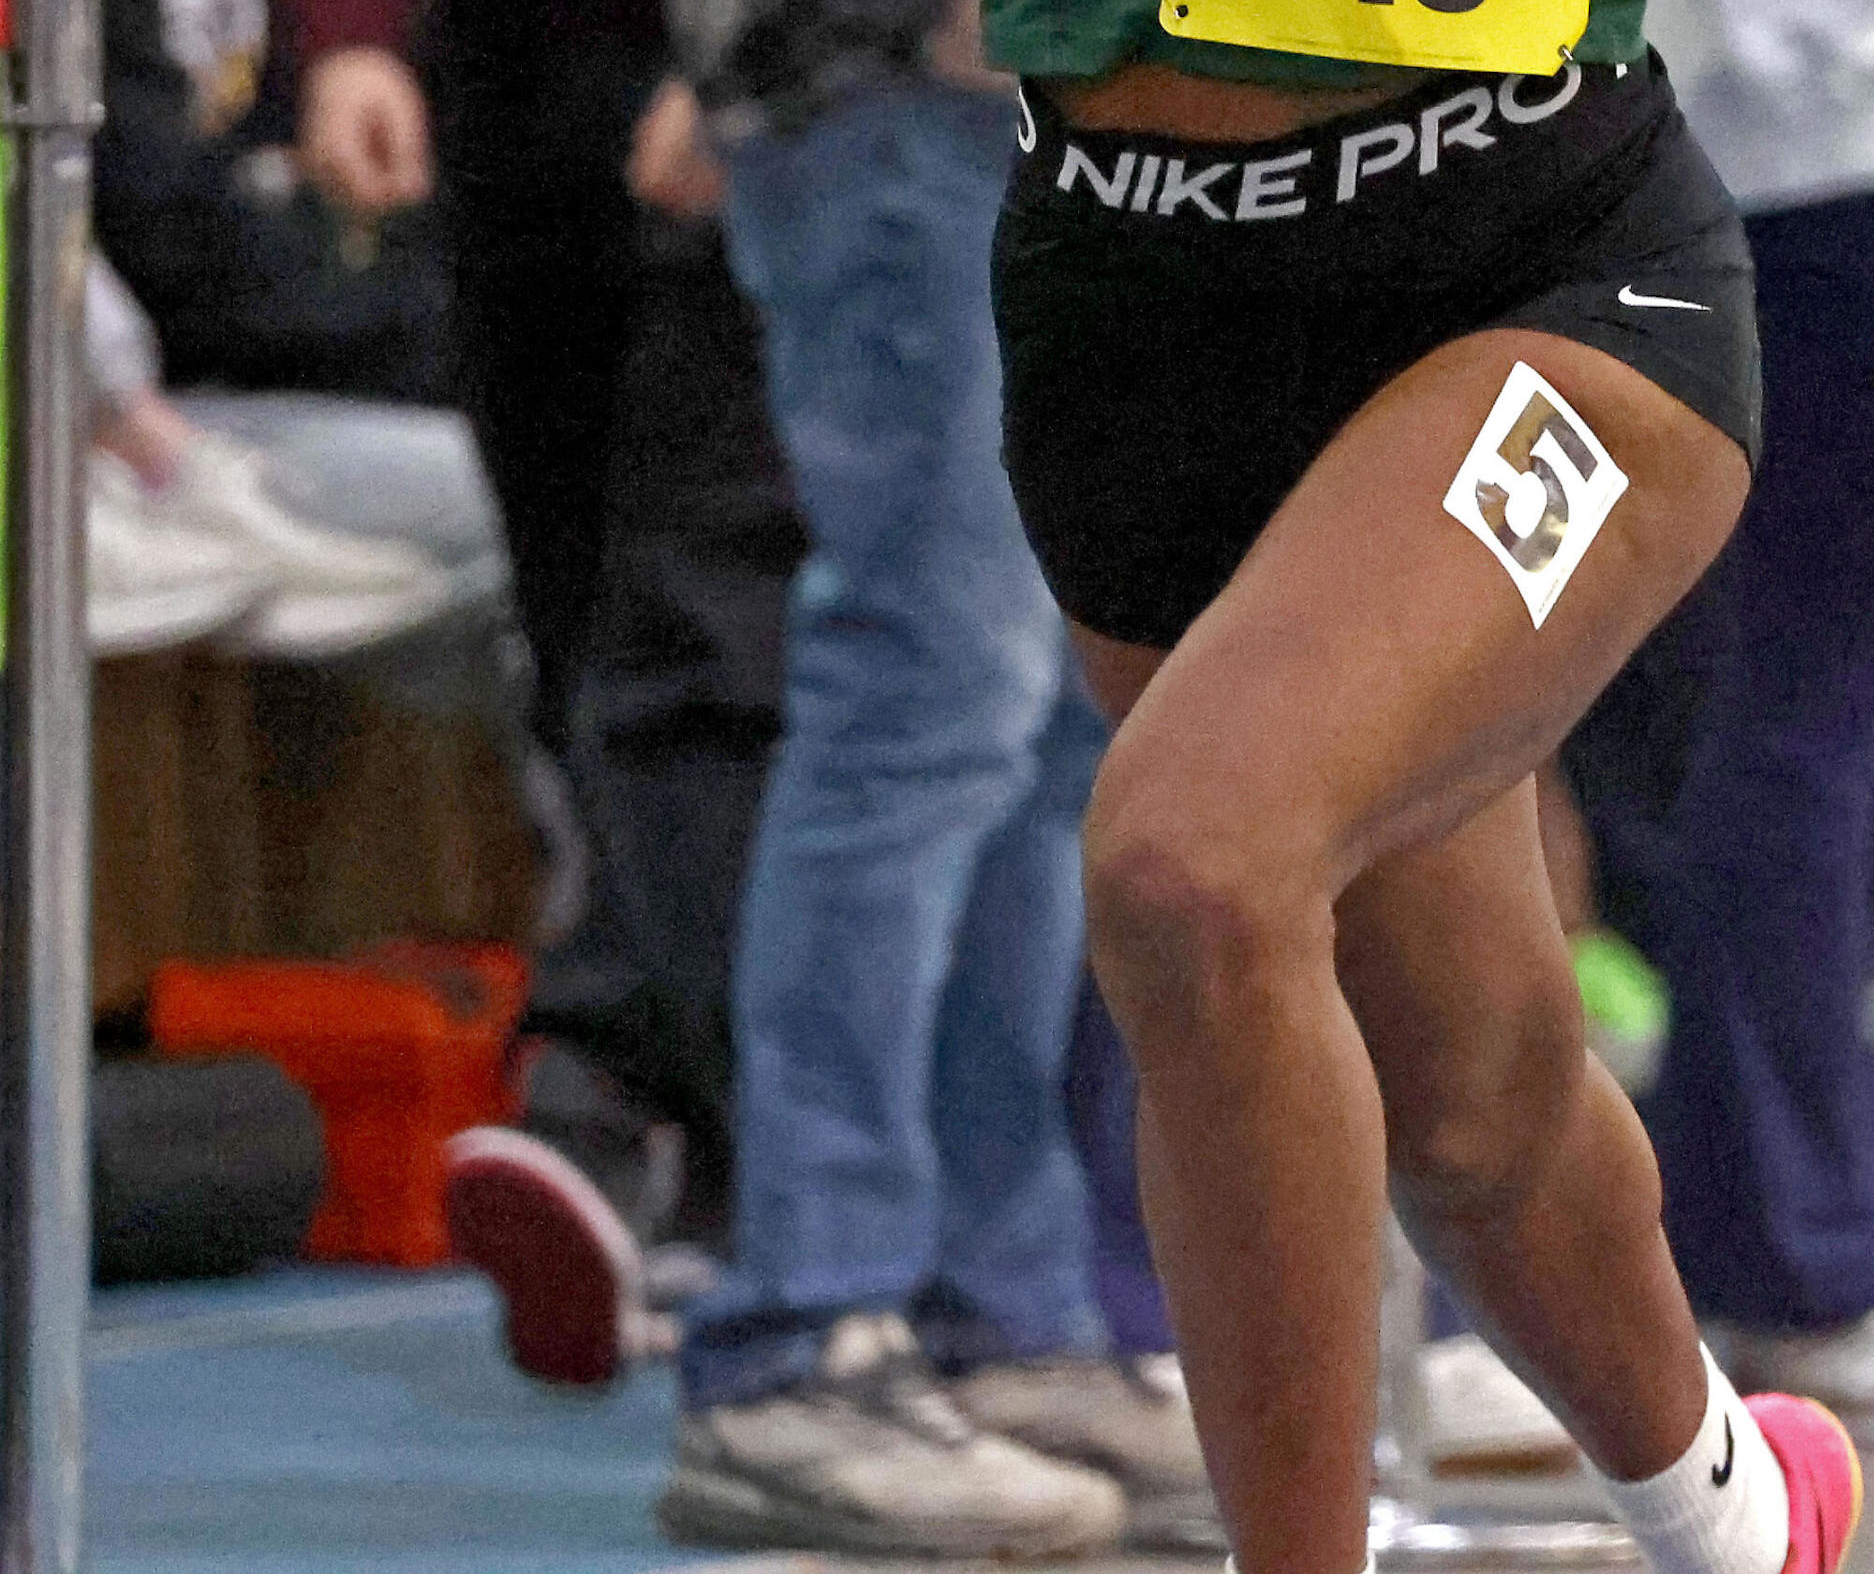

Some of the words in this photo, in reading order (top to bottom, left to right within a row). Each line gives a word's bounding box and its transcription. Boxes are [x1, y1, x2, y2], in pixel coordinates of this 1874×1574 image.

[1056, 144, 1313, 221] NIKE
[1335, 60, 1582, 203] PRO
[1475, 391, 1598, 574] 5
